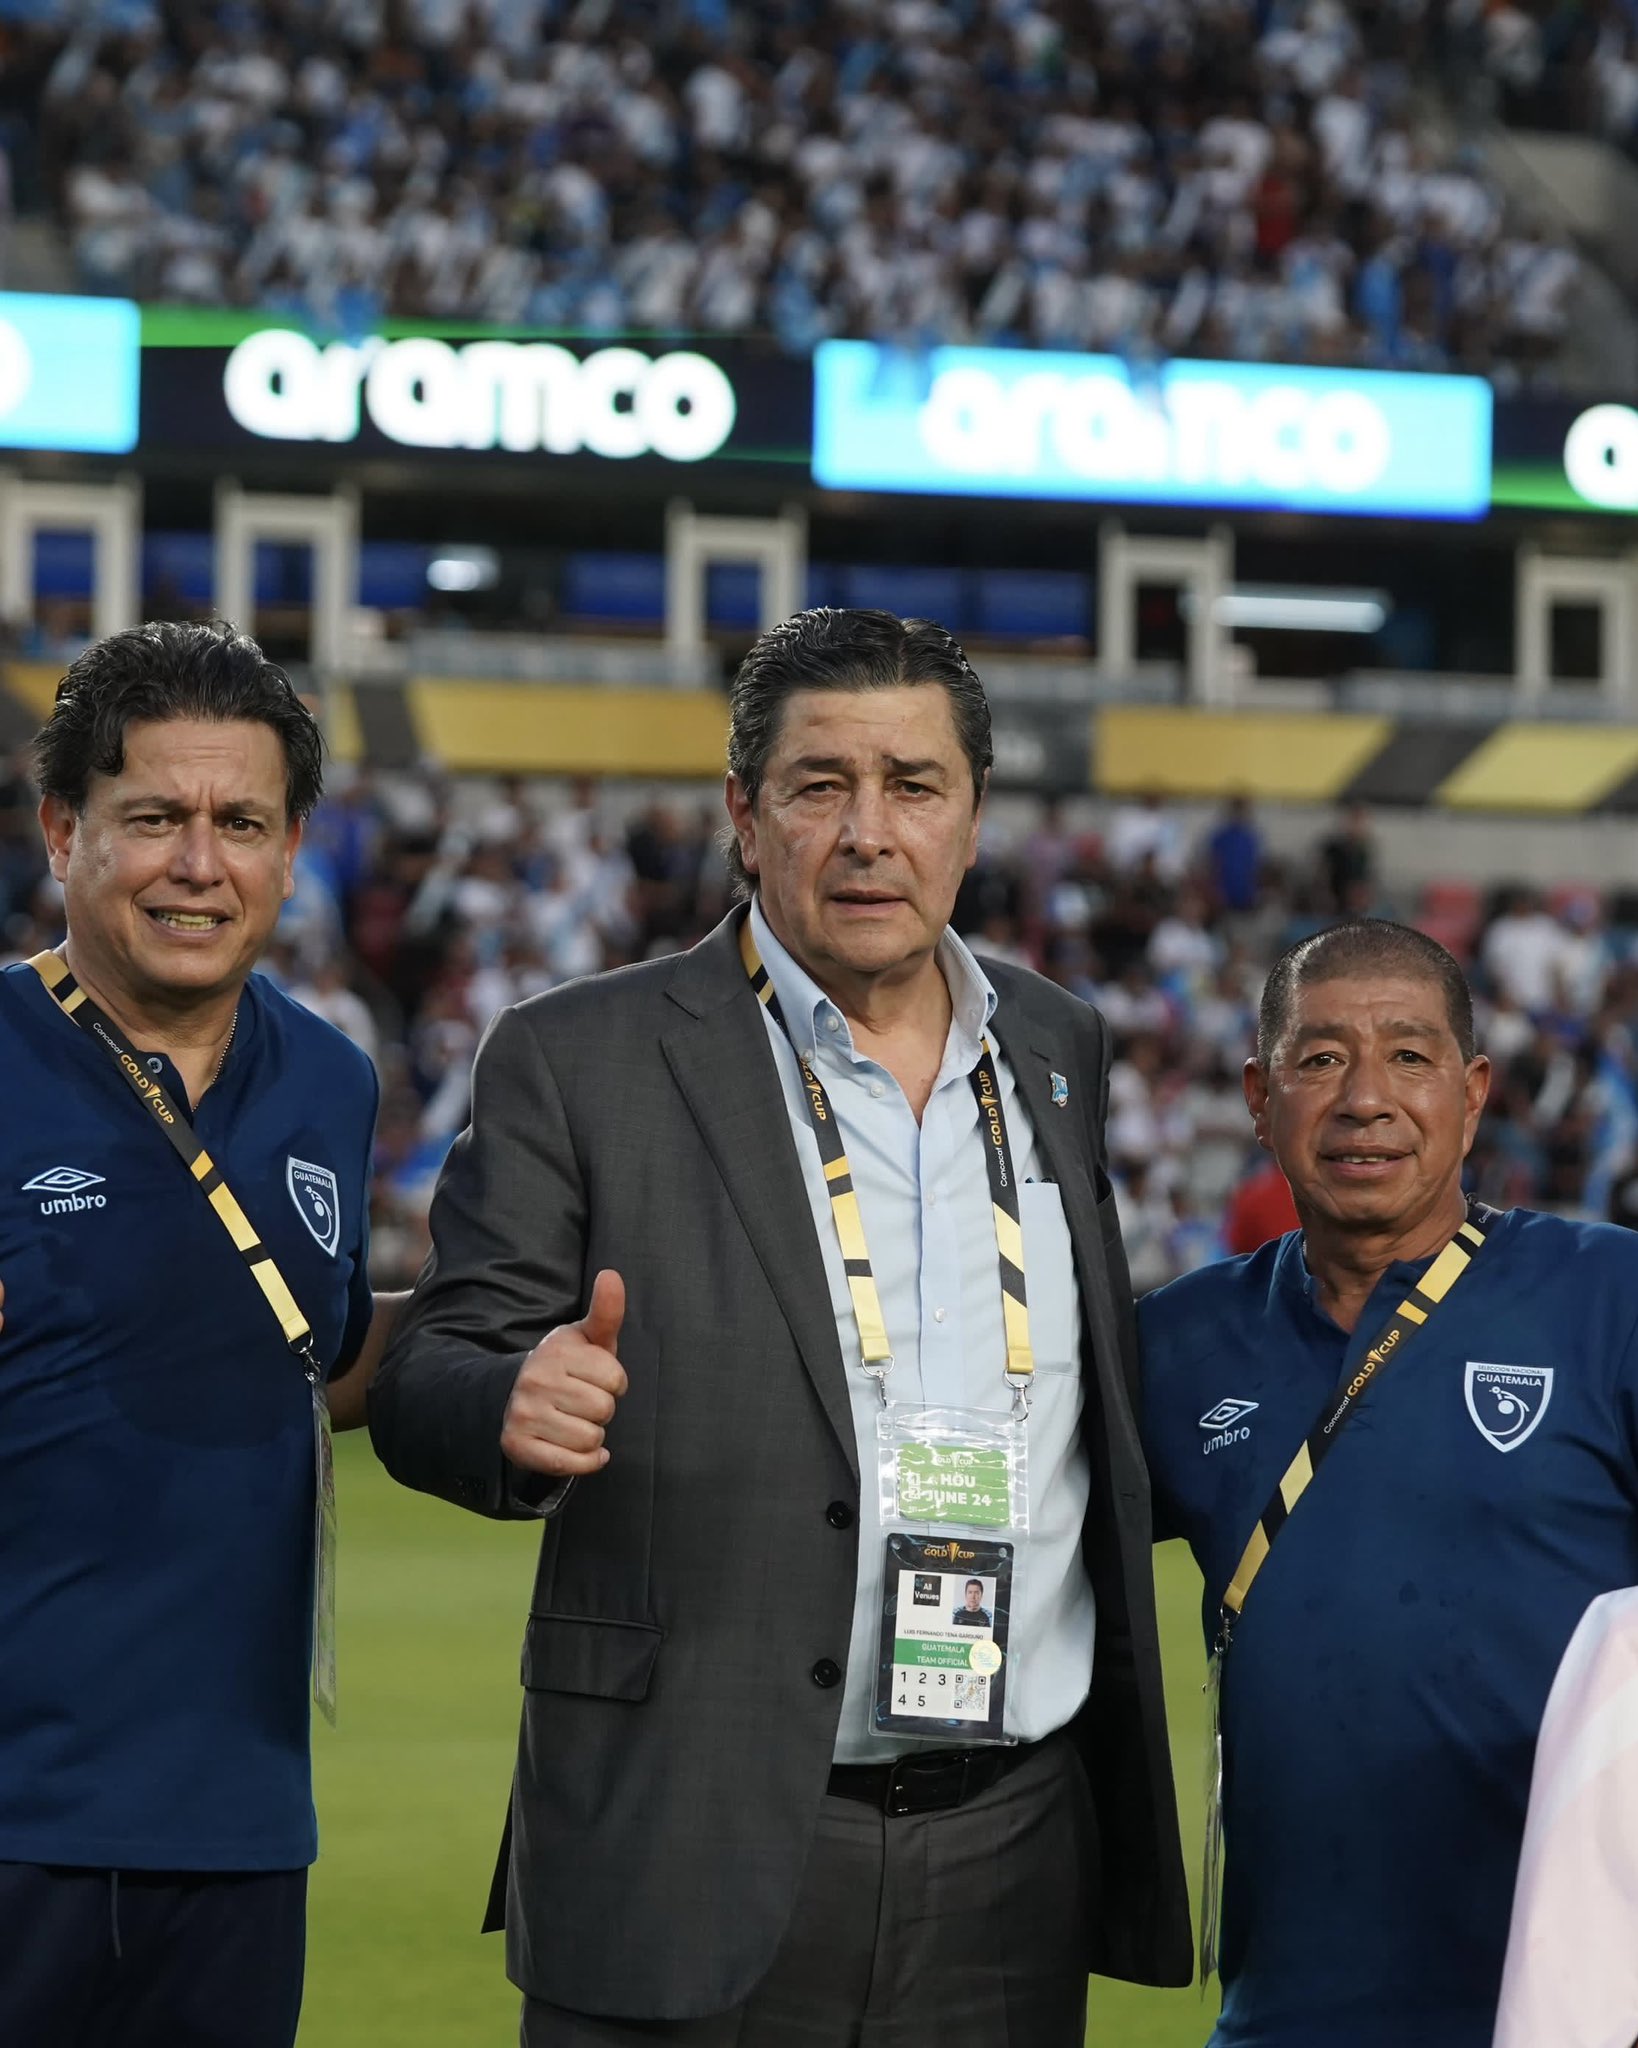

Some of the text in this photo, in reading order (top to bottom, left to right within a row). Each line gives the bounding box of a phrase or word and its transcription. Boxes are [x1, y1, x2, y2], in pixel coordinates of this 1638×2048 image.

[224, 329, 736, 461] aramco
[93, 1022, 175, 1124] Concacaf GOLD CUP
[812, 1093, 827, 1121] CUP
[978, 1070, 1008, 1187] Concacaf GOLD CUP
[293, 1170, 333, 1190] GUATEMALA
[40, 1193, 107, 1215] umbro
[1323, 1329, 1400, 1434] Concacaf GOLD CUP
[1476, 1373, 1542, 1387] GUATEMALA
[1203, 1426, 1251, 1455] umbro
[939, 1472, 977, 1489] HOU
[925, 1489, 993, 1507] JUNE 24
[923, 1548, 976, 1560] GOLD CUP
[922, 1582, 933, 1591] All
[914, 1590, 940, 1601] Venues
[921, 1643, 965, 1654] GUATEMALA
[916, 1655, 937, 1665] TEAM
[937, 1658, 969, 1667] OFFICIAL
[901, 1671, 946, 1686] 1 2 3
[898, 1694, 926, 1707] 4 5
